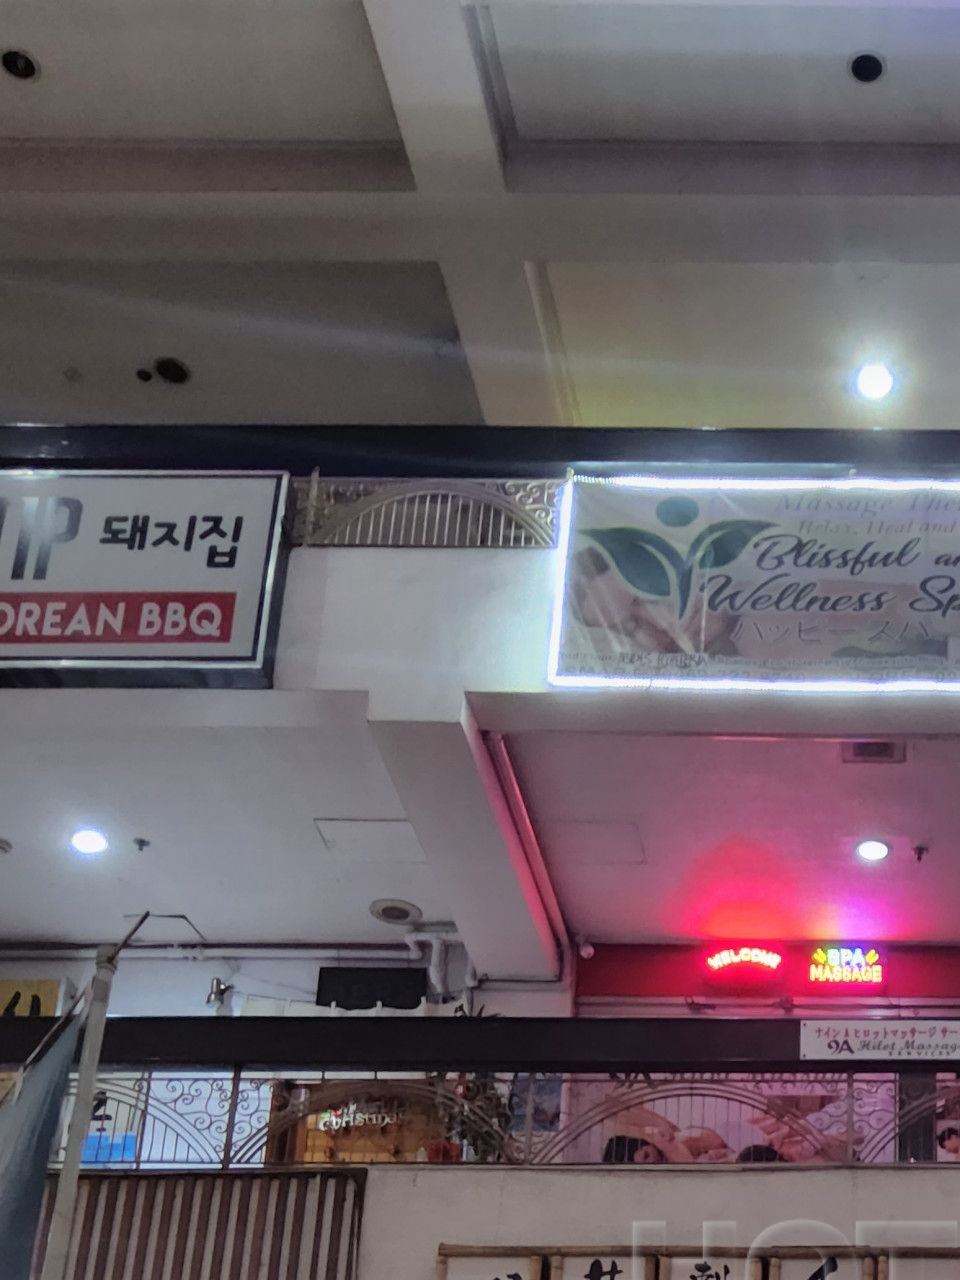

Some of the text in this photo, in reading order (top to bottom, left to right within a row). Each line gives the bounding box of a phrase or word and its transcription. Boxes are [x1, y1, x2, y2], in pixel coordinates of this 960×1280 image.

[775, 495, 894, 520] Massage
[100, 515, 242, 569] 돼지집
[918, 519, 954, 535] and
[753, 534, 921, 573] Blissful
[698, 573, 897, 614] Wellness
[138, 602, 222, 638] BBQ
[827, 947, 866, 967] SPA
[810, 964, 883, 984] MASSAGE
